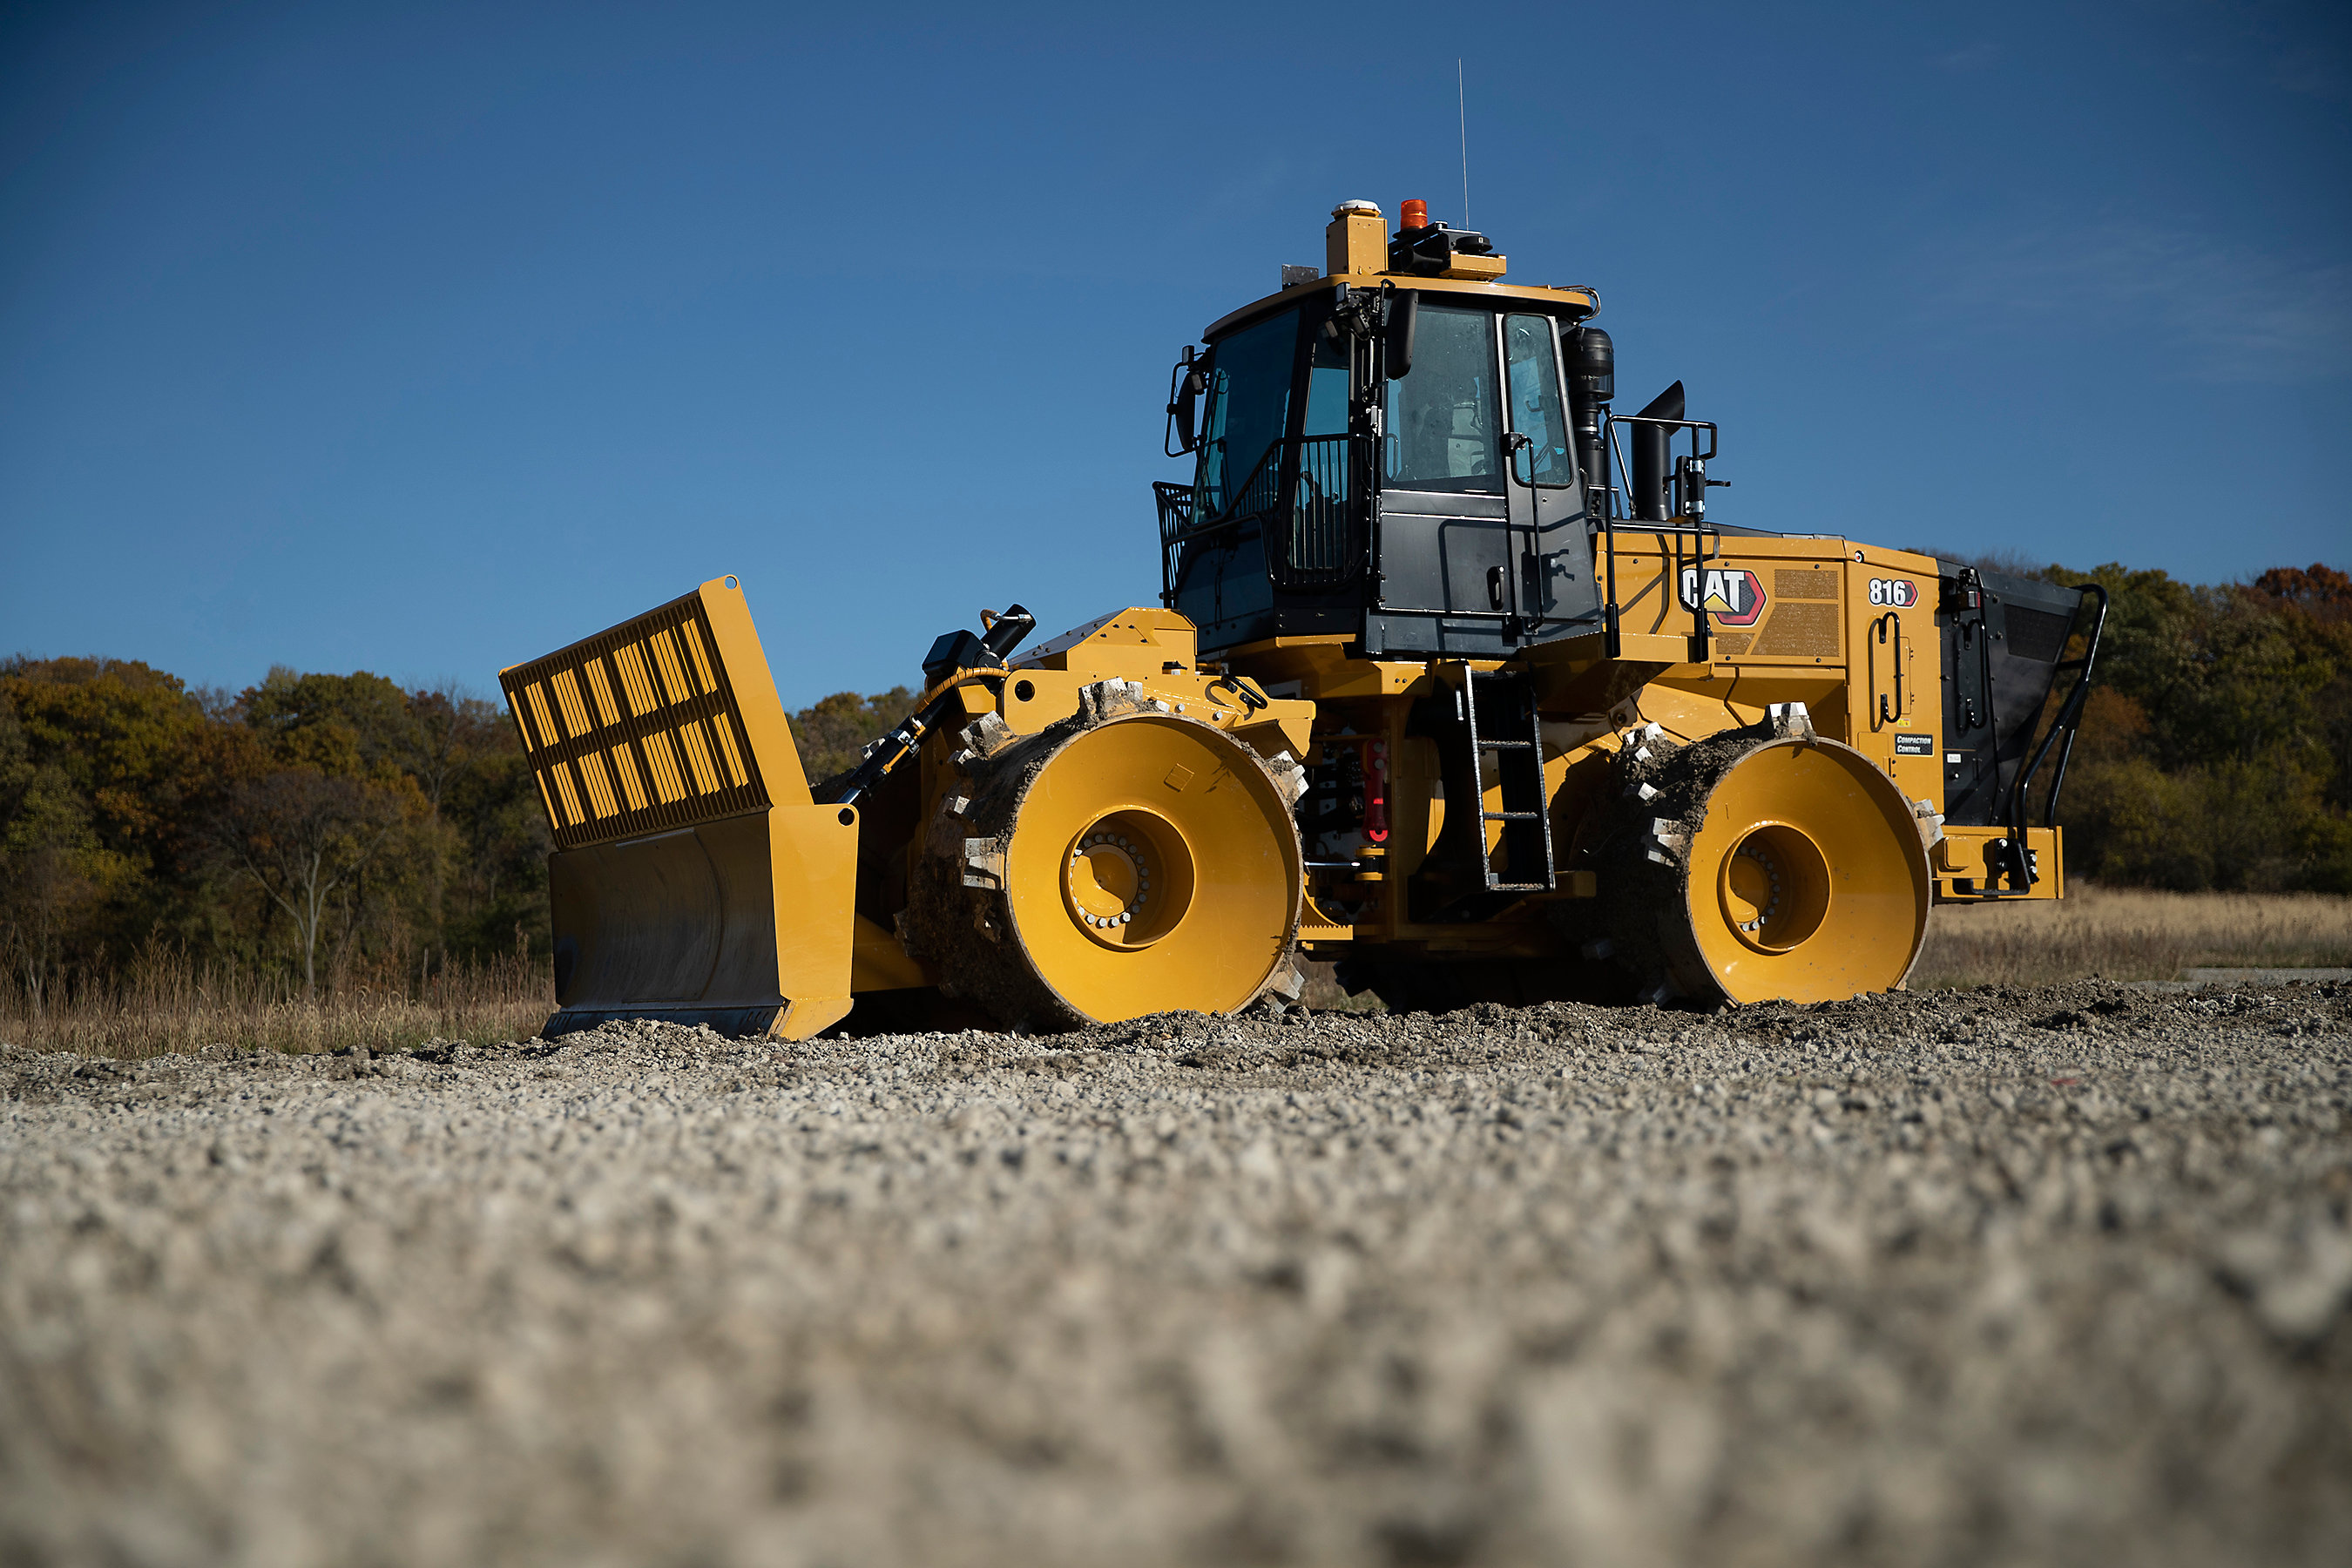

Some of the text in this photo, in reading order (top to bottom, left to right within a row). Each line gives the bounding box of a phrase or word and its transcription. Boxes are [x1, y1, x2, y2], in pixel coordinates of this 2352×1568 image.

[1681, 569, 1745, 612] CAT
[1869, 578, 1906, 605] 816
[1896, 735, 1931, 745] COMPACTION
